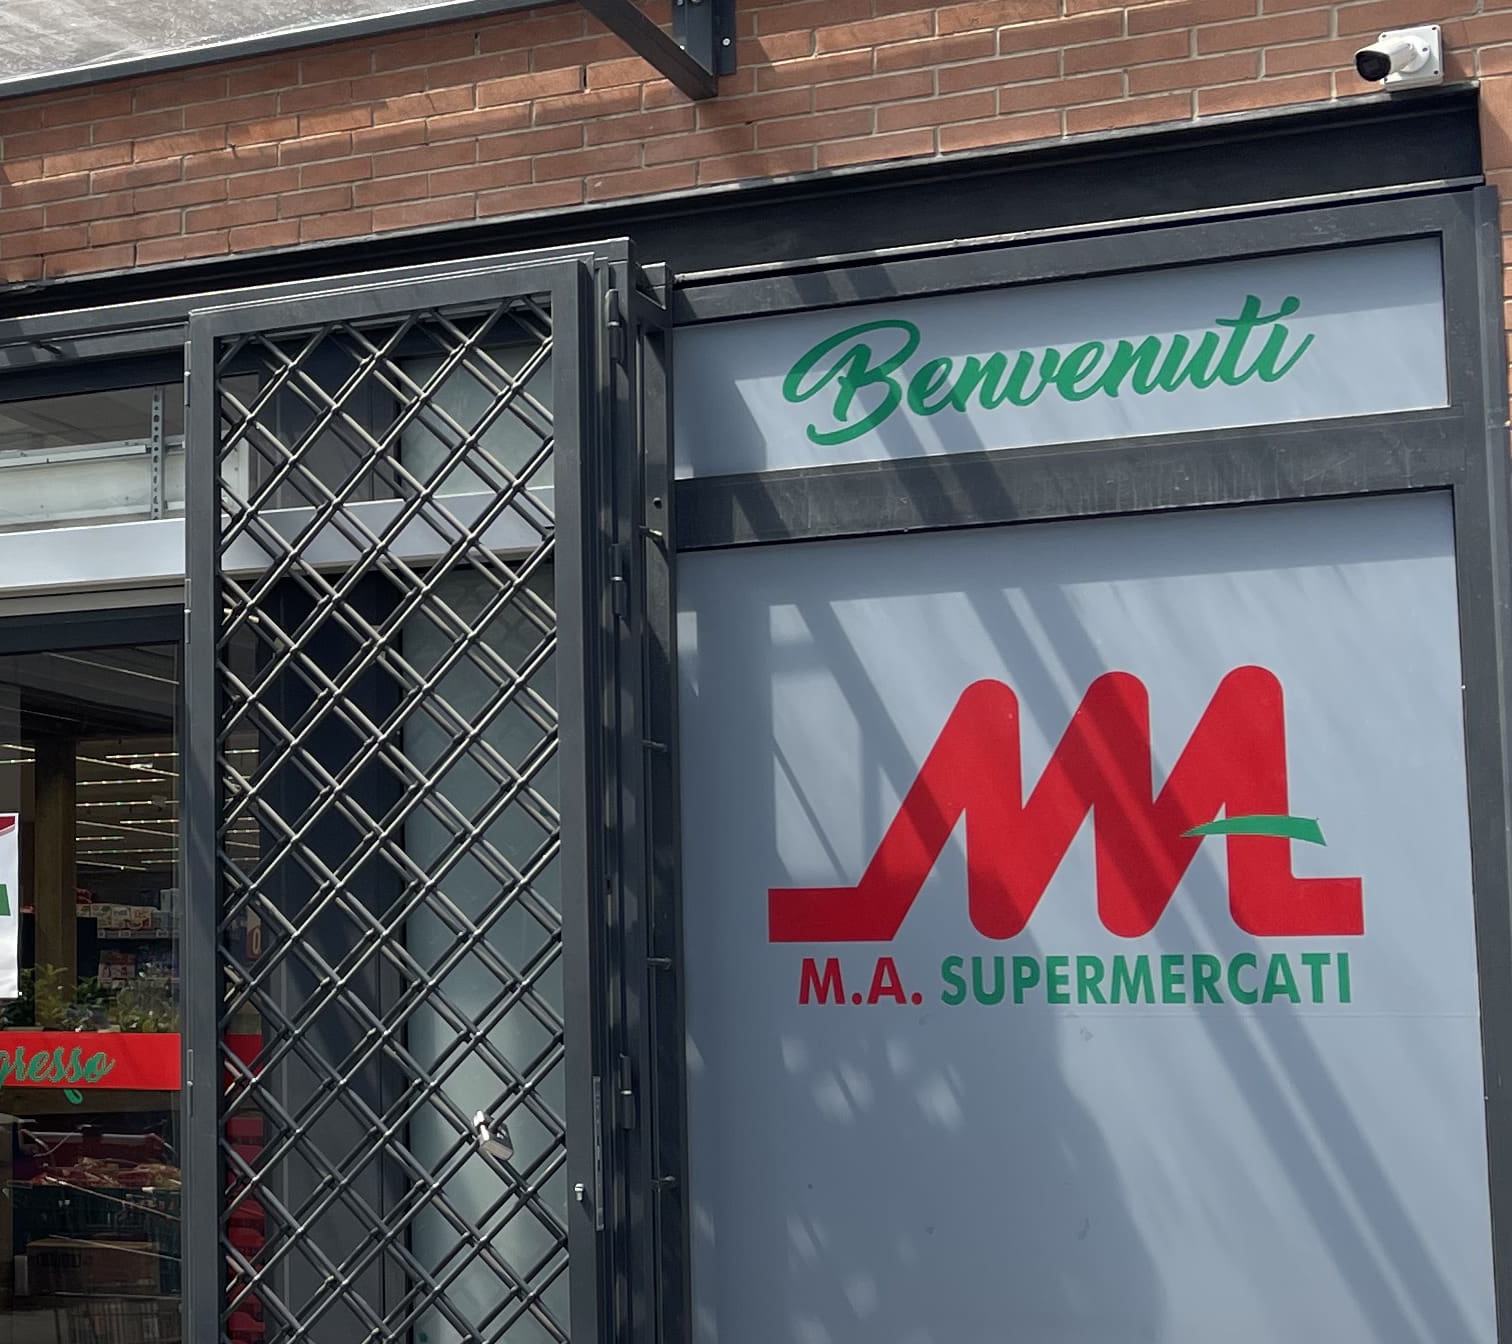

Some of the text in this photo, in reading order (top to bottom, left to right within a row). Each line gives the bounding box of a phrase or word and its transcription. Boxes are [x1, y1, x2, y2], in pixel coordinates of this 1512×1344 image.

[782, 294, 1315, 447] Benvenuti
[799, 953, 1352, 1006] M.A. SUPERMERCATI
